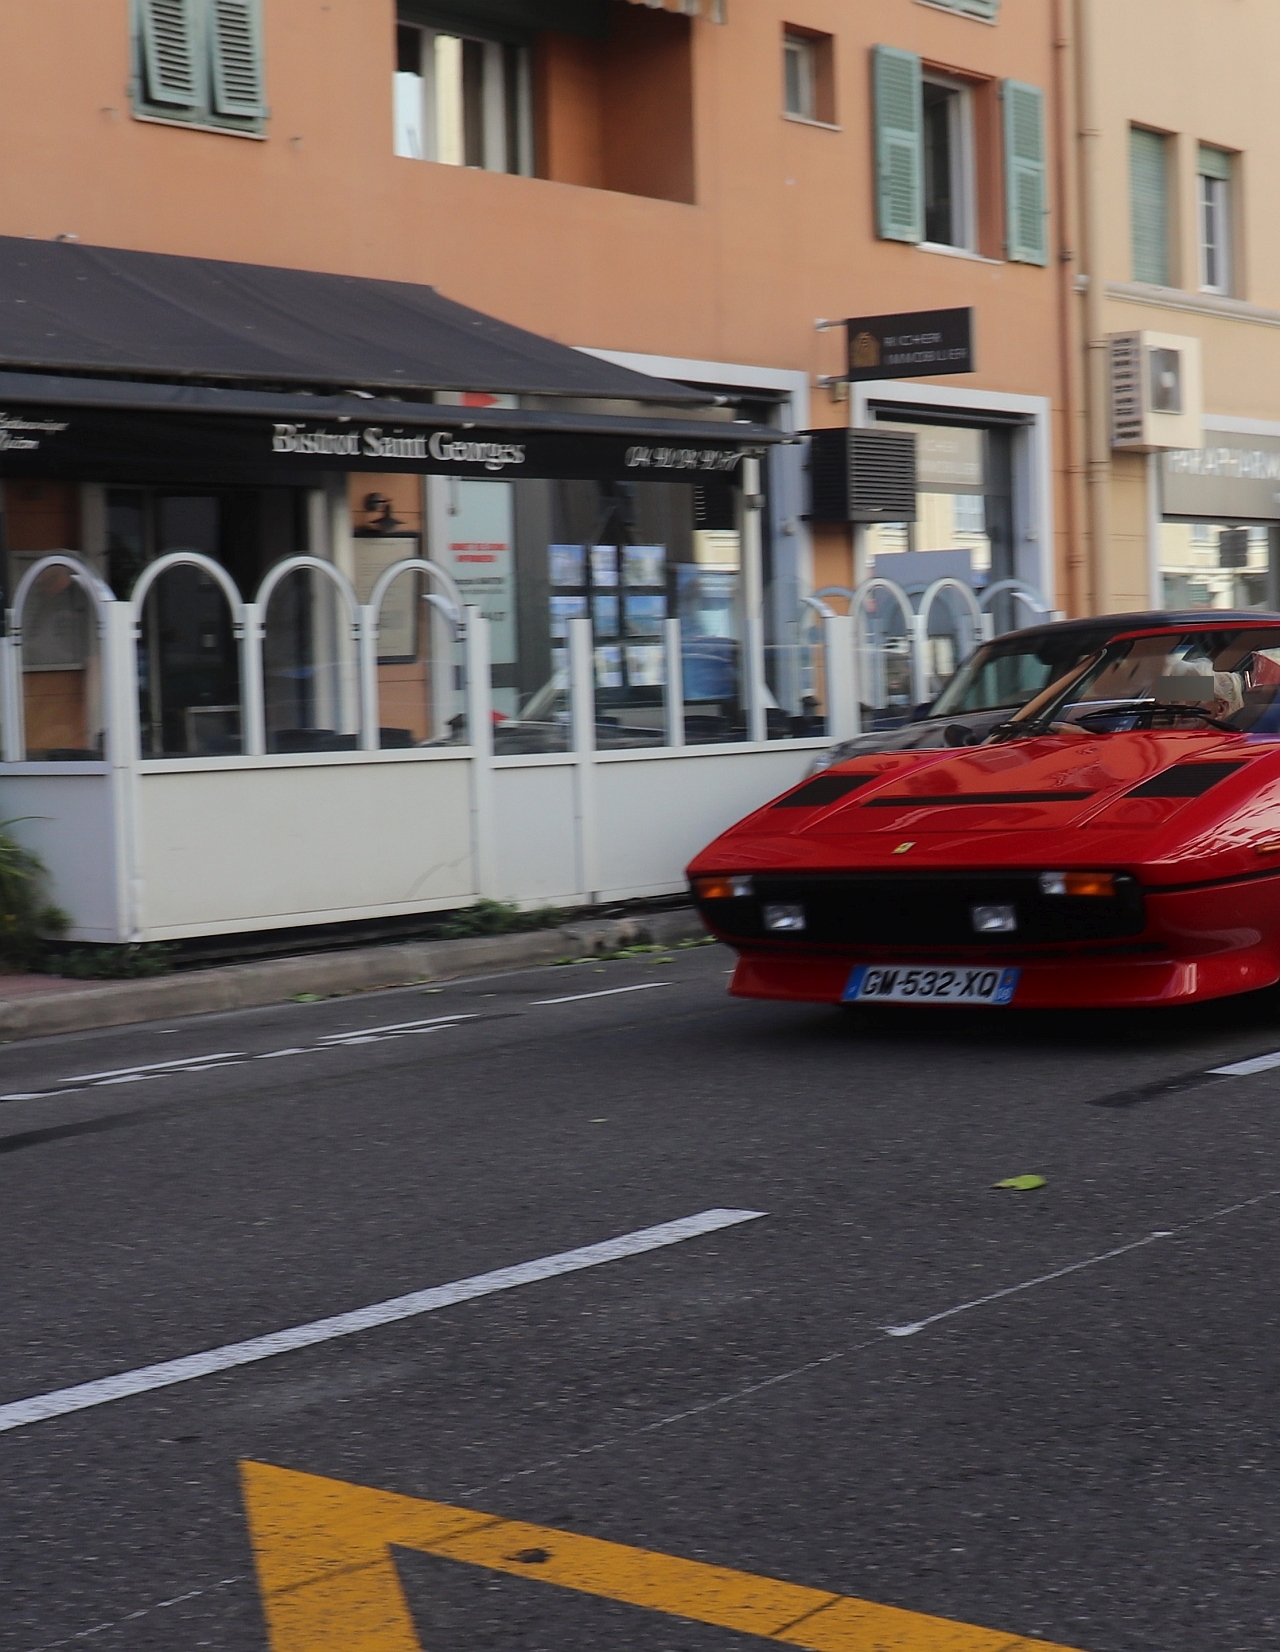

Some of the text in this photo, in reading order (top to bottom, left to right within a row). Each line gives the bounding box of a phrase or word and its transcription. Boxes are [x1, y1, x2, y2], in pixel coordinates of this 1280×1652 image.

[883, 332, 942, 347] RICHER
[272, 424, 526, 470] Bistrot Saint Georges
